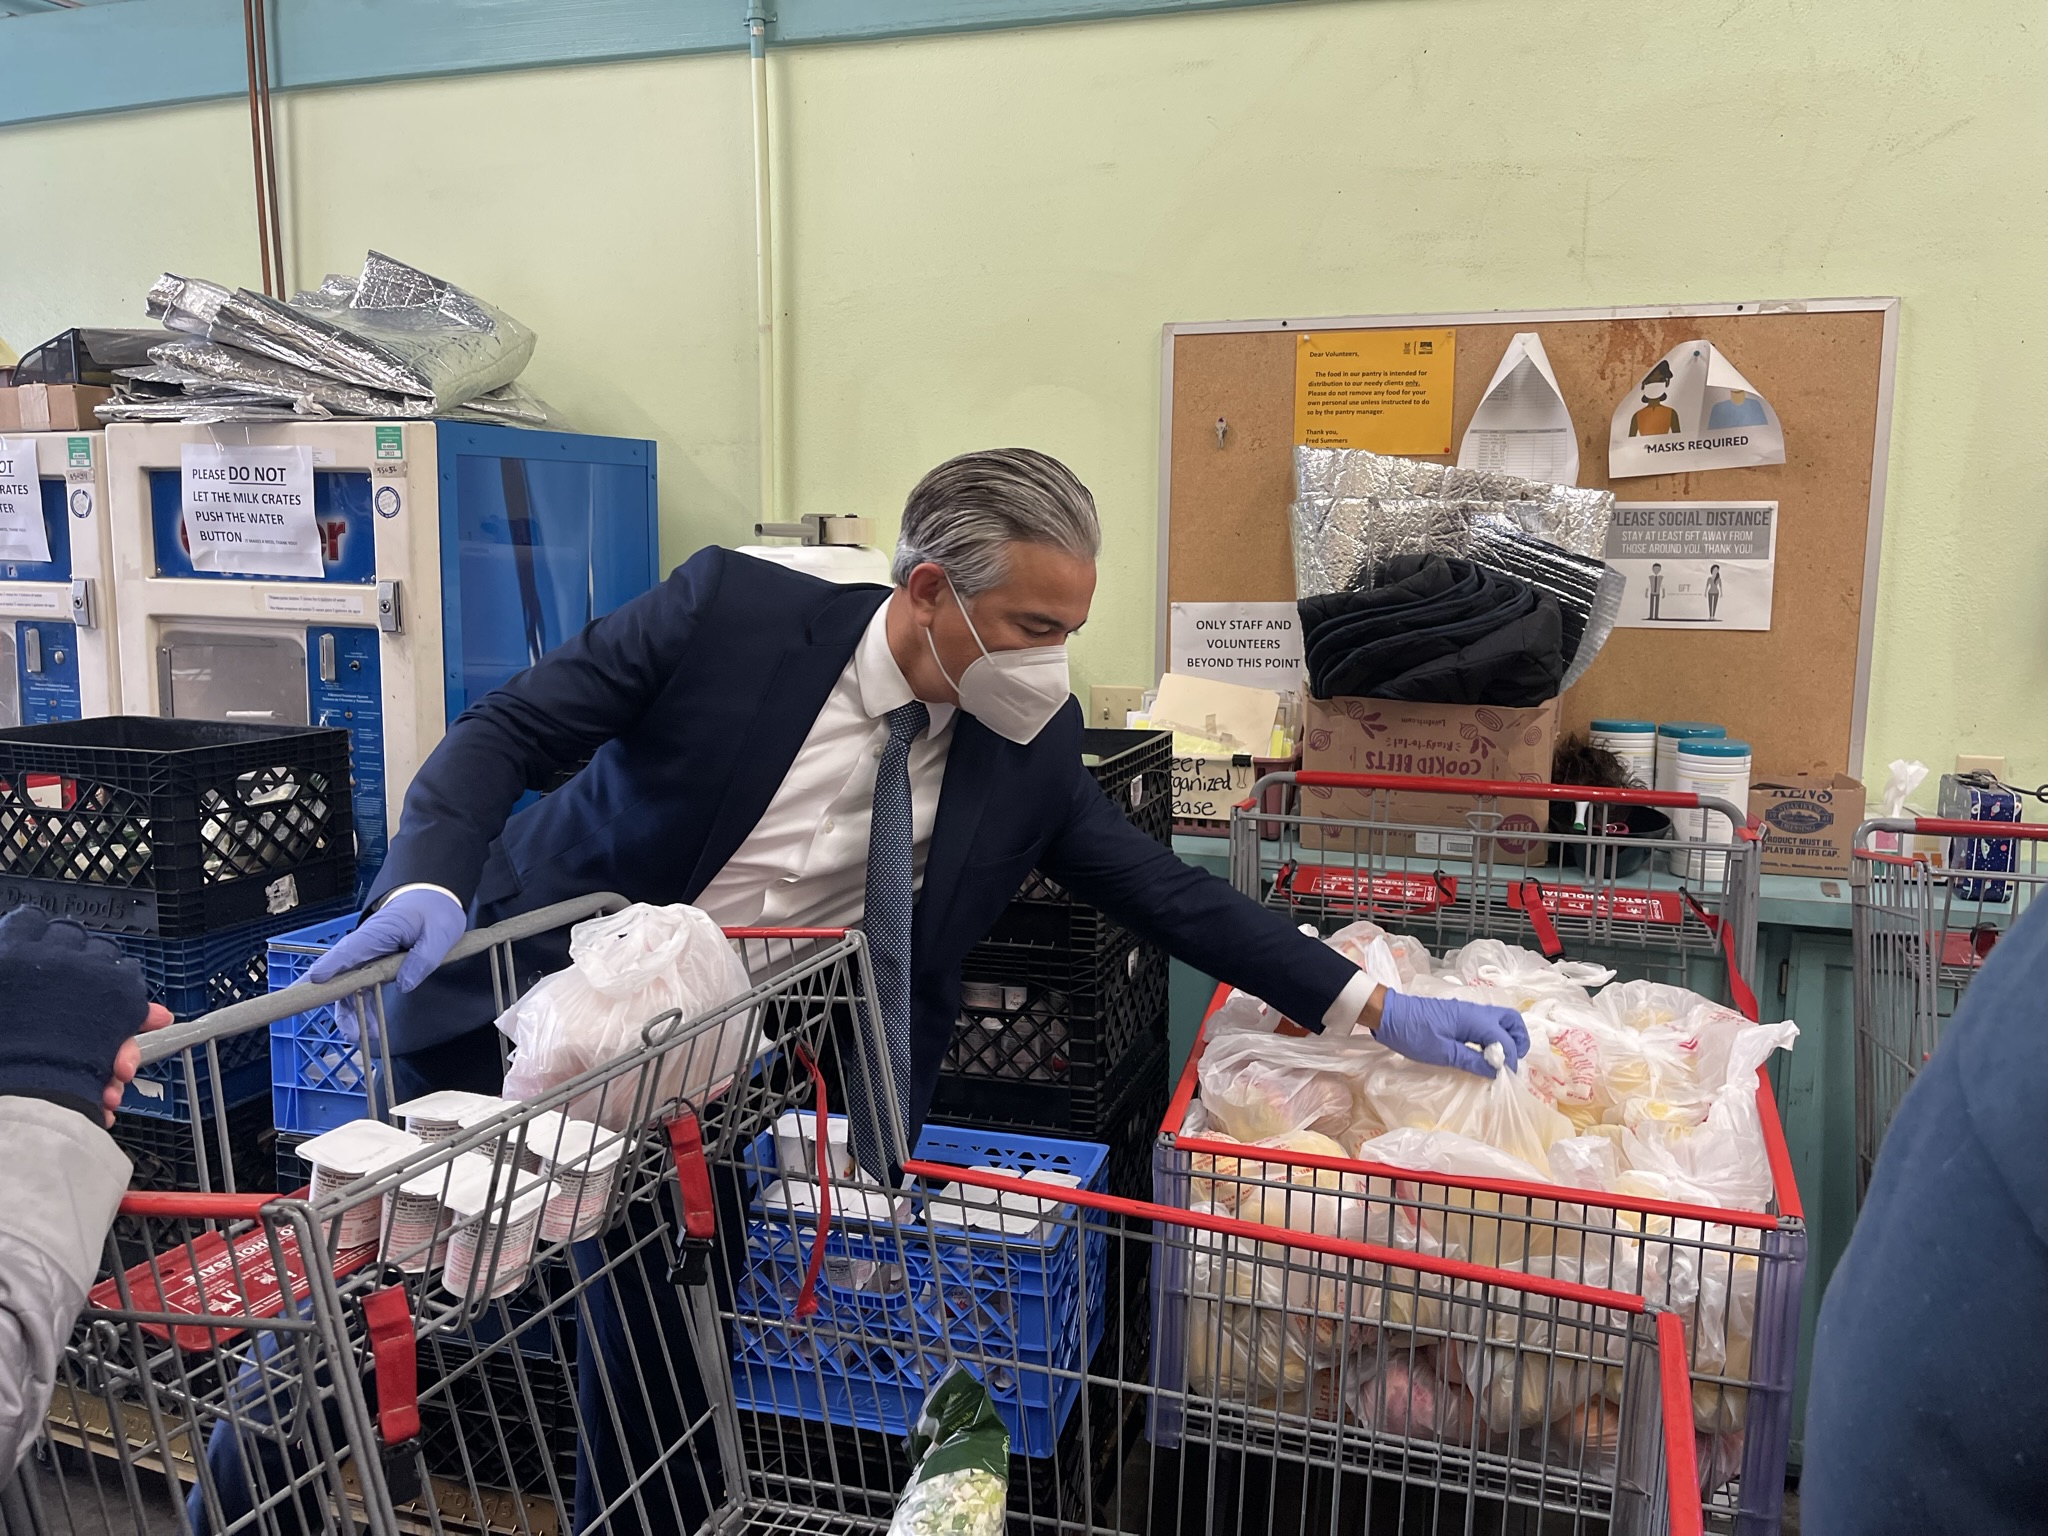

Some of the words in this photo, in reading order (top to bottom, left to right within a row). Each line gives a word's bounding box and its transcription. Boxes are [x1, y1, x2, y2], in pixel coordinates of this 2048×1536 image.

[1647, 441, 1685, 454] MASKS
[1688, 436, 1749, 450] REQUIRED
[0, 460, 14, 474] OT
[192, 469, 226, 480] PLEASE
[229, 466, 250, 481] DO
[255, 467, 286, 482] NOT
[0, 485, 28, 495] RATES
[193, 491, 208, 502] LET
[211, 492, 231, 502] THE
[234, 493, 259, 504] MILK
[262, 494, 301, 506] CRATES
[0, 504, 15, 513] TER
[196, 511, 224, 522] PUSH
[225, 512, 246, 522] THE
[247, 513, 285, 525] WATER
[1658, 511, 1702, 526] SOCIAL
[1706, 511, 1769, 526] DISTANCE
[200, 531, 242, 542] BUTTON
[1622, 531, 1643, 541] STAY
[1645, 531, 1656, 540] AT
[1658, 531, 1683, 540] LEAST
[1685, 531, 1700, 540] 6FT
[1702, 531, 1726, 540] AWAY
[1729, 531, 1753, 540] FROM
[1622, 544, 1646, 554] THOSE
[1649, 544, 1681, 554] AROUND
[1704, 544, 1731, 554] THANK
[1734, 544, 1753, 554] YOU!
[1196, 620, 1226, 630] ONLY
[1230, 620, 1263, 630] STAFF
[1266, 620, 1292, 630] AND
[1206, 639, 1280, 649] VOLUNTEERS
[1187, 658, 1234, 668] BEYOND
[1236, 658, 1262, 668] THIS
[1265, 659, 1300, 668] POINT
[1172, 758, 1206, 775] eep
[1366, 751, 1412, 773] BEETS
[1417, 756, 1481, 776] COOKED
[1171, 769, 1232, 797] ganized
[1172, 800, 1216, 815] ease
[1767, 836, 1797, 844] RODUCT
[1761, 846, 1793, 854] SPLAYED
[64, 894, 124, 919] Foods
